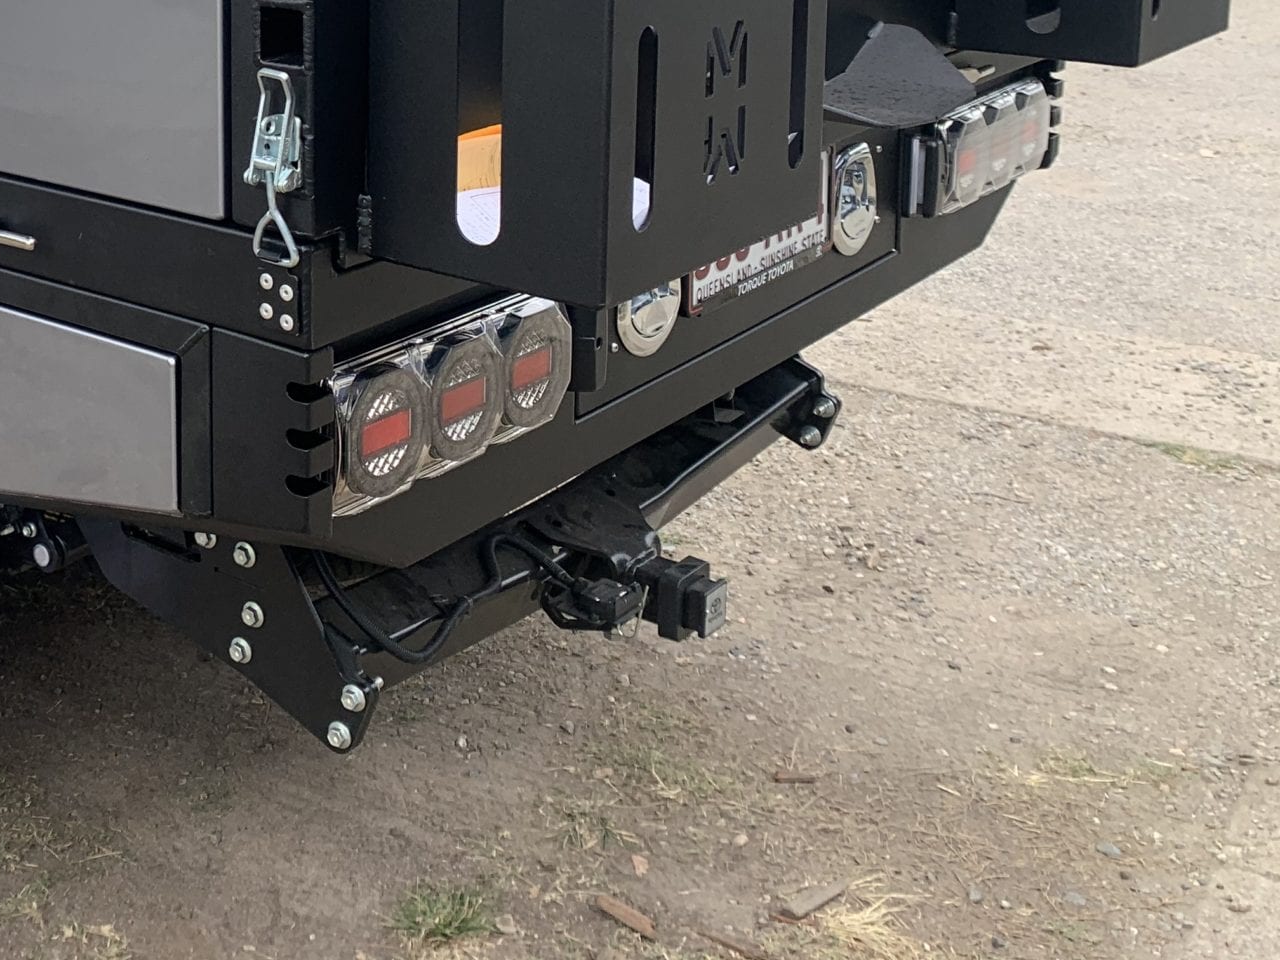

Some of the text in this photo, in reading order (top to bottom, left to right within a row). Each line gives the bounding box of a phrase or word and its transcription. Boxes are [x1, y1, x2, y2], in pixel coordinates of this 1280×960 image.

[696, 263, 753, 302] QUEENSLAND
[760, 241, 799, 271] SUNSHINE
[738, 275, 767, 297] TORQUE
[767, 259, 794, 282] TOYOTA
